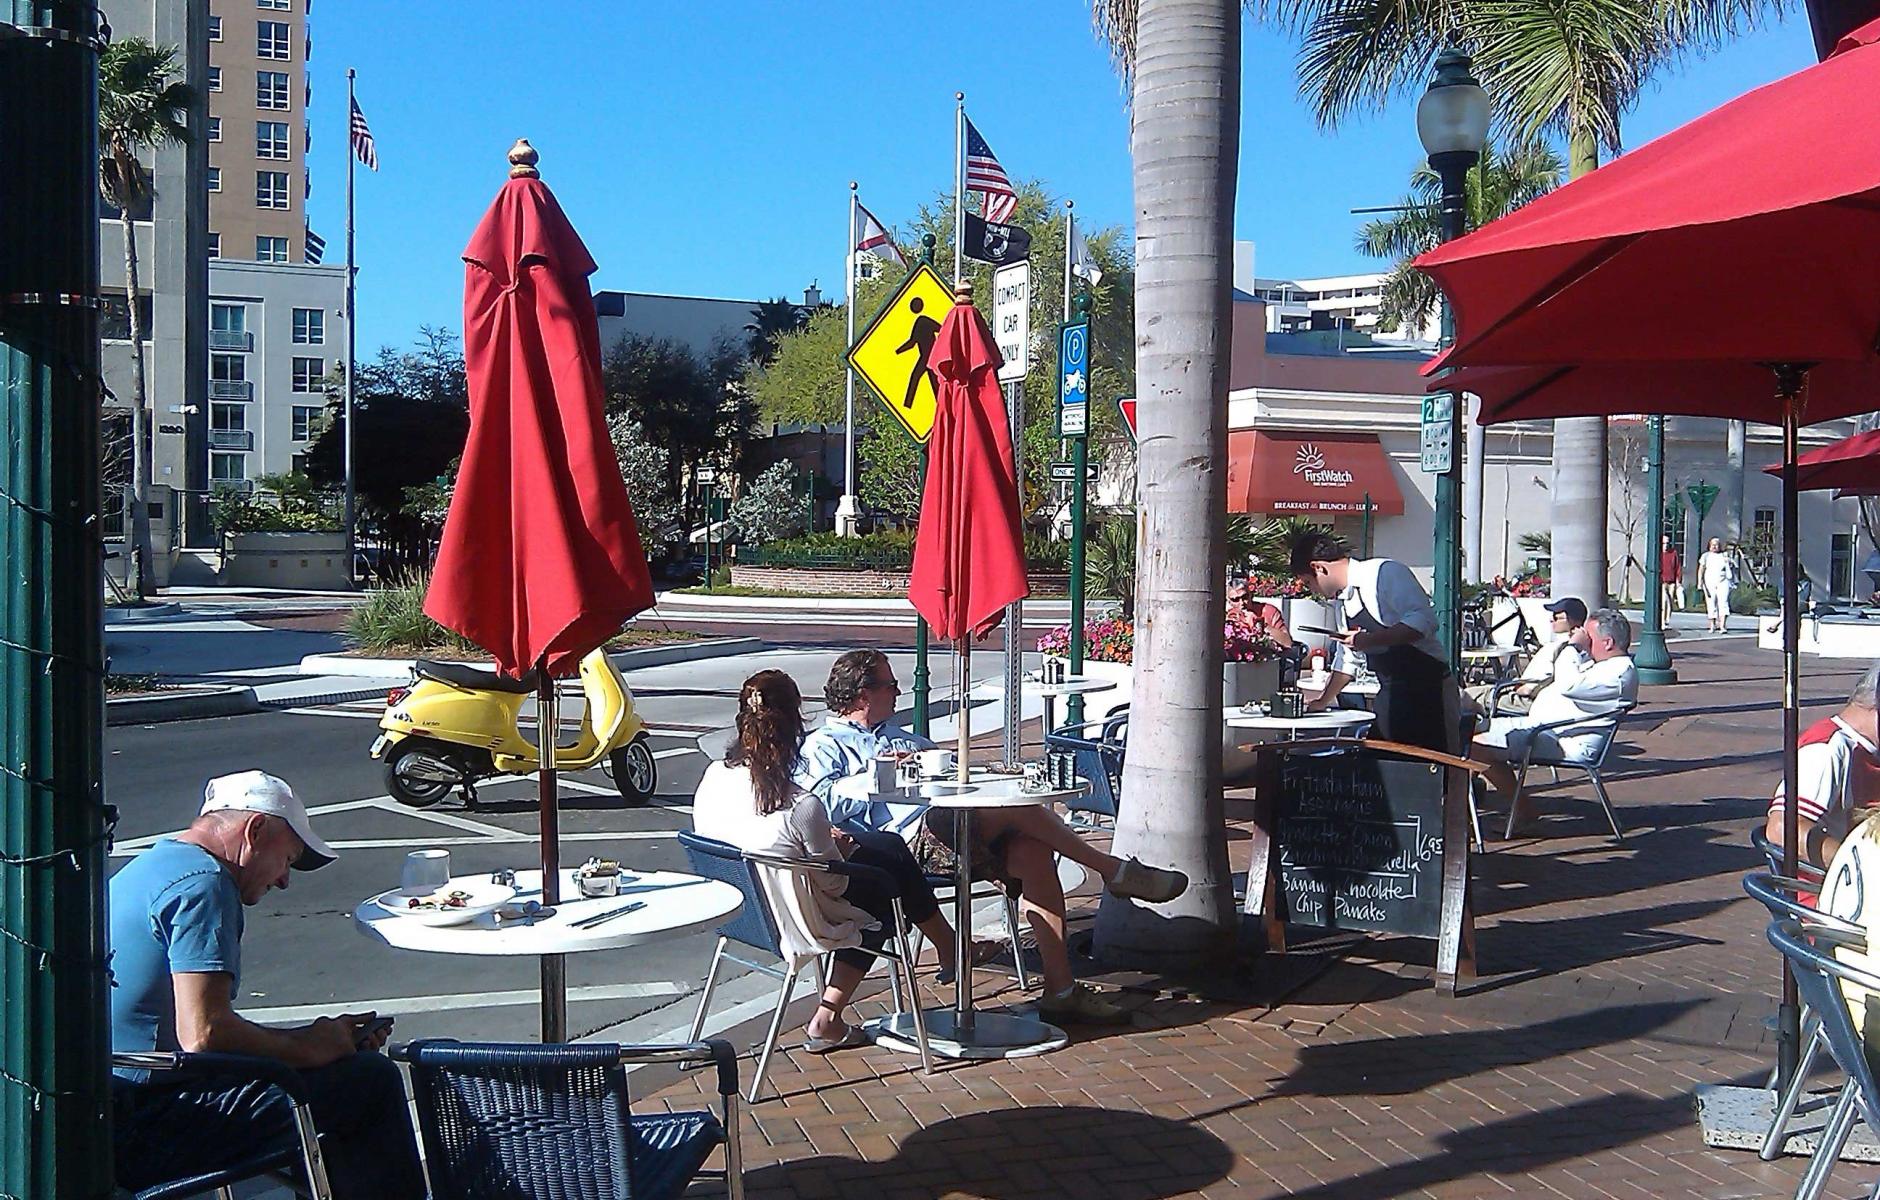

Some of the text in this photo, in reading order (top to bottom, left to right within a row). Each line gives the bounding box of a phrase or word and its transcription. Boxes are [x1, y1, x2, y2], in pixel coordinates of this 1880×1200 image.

[997, 282, 1026, 306] COMPACT
[1003, 314, 1019, 333] CAR
[1001, 344, 1020, 363] ONLY
[1072, 338, 1079, 359] P
[1425, 401, 1433, 421] 2
[1054, 467, 1068, 476] ONE
[1274, 502, 1309, 510] BREAKFAST
[1319, 503, 1347, 511] BRUNCH
[1295, 891, 1324, 922] Chip
